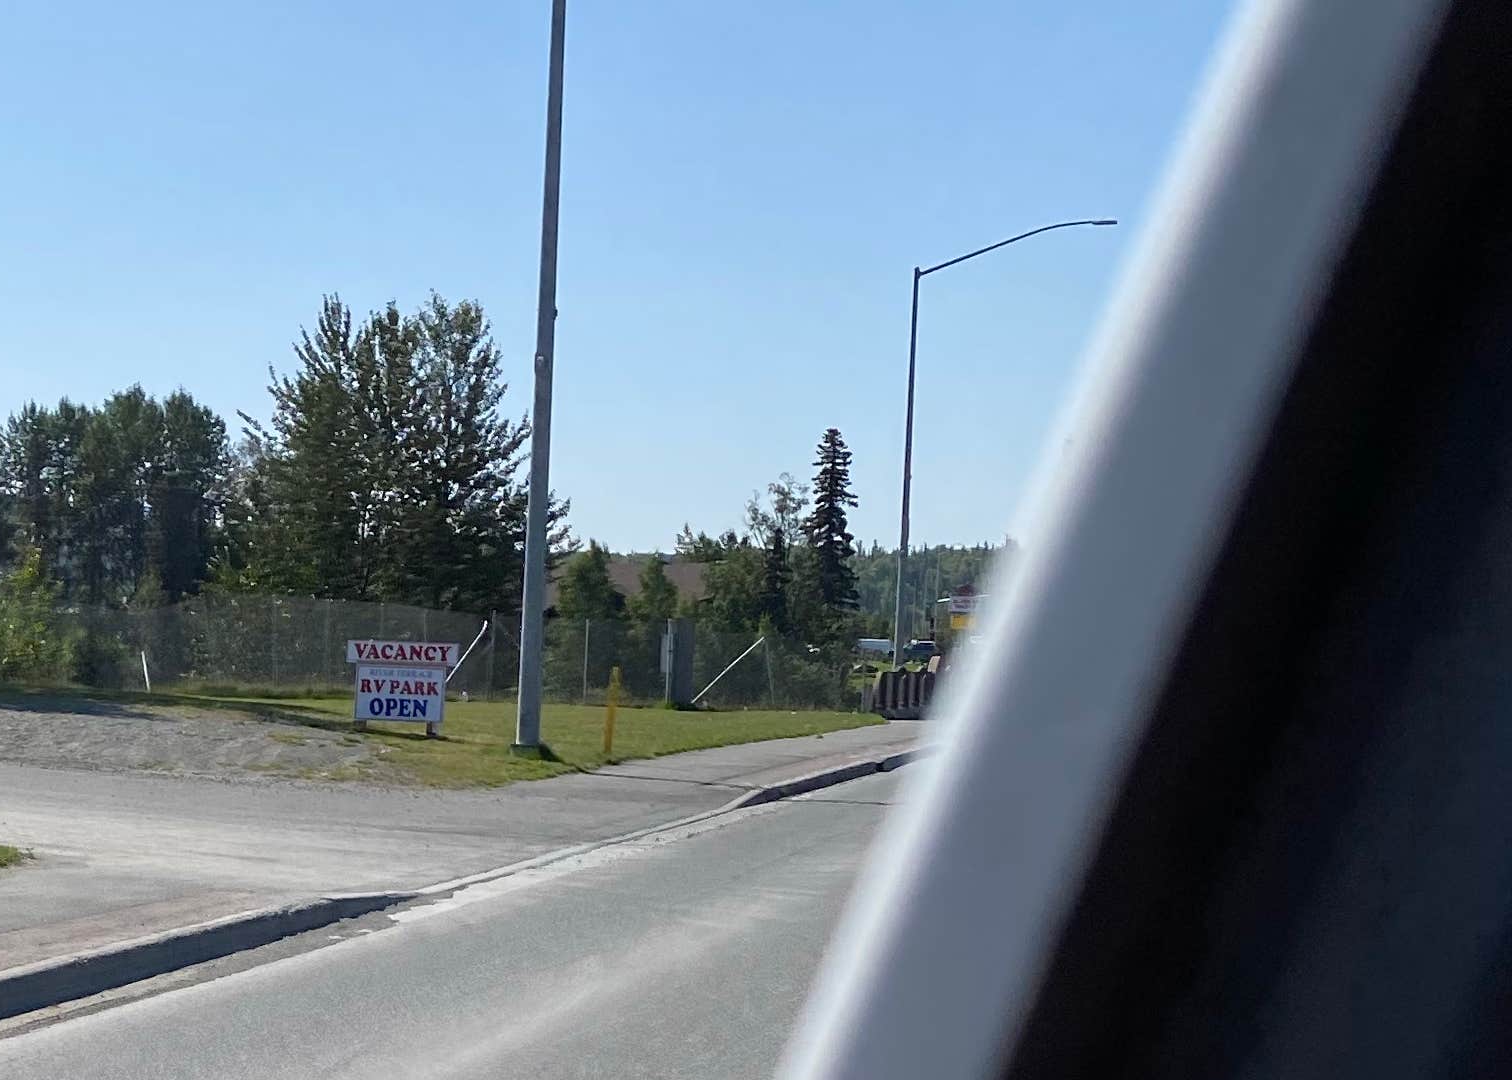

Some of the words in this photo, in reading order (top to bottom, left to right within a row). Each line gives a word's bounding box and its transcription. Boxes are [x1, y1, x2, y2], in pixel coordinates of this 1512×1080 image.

[354, 643, 452, 661] VACANCY
[360, 679, 386, 693] RV
[389, 680, 439, 696] PARK
[369, 698, 428, 717] OPEN
